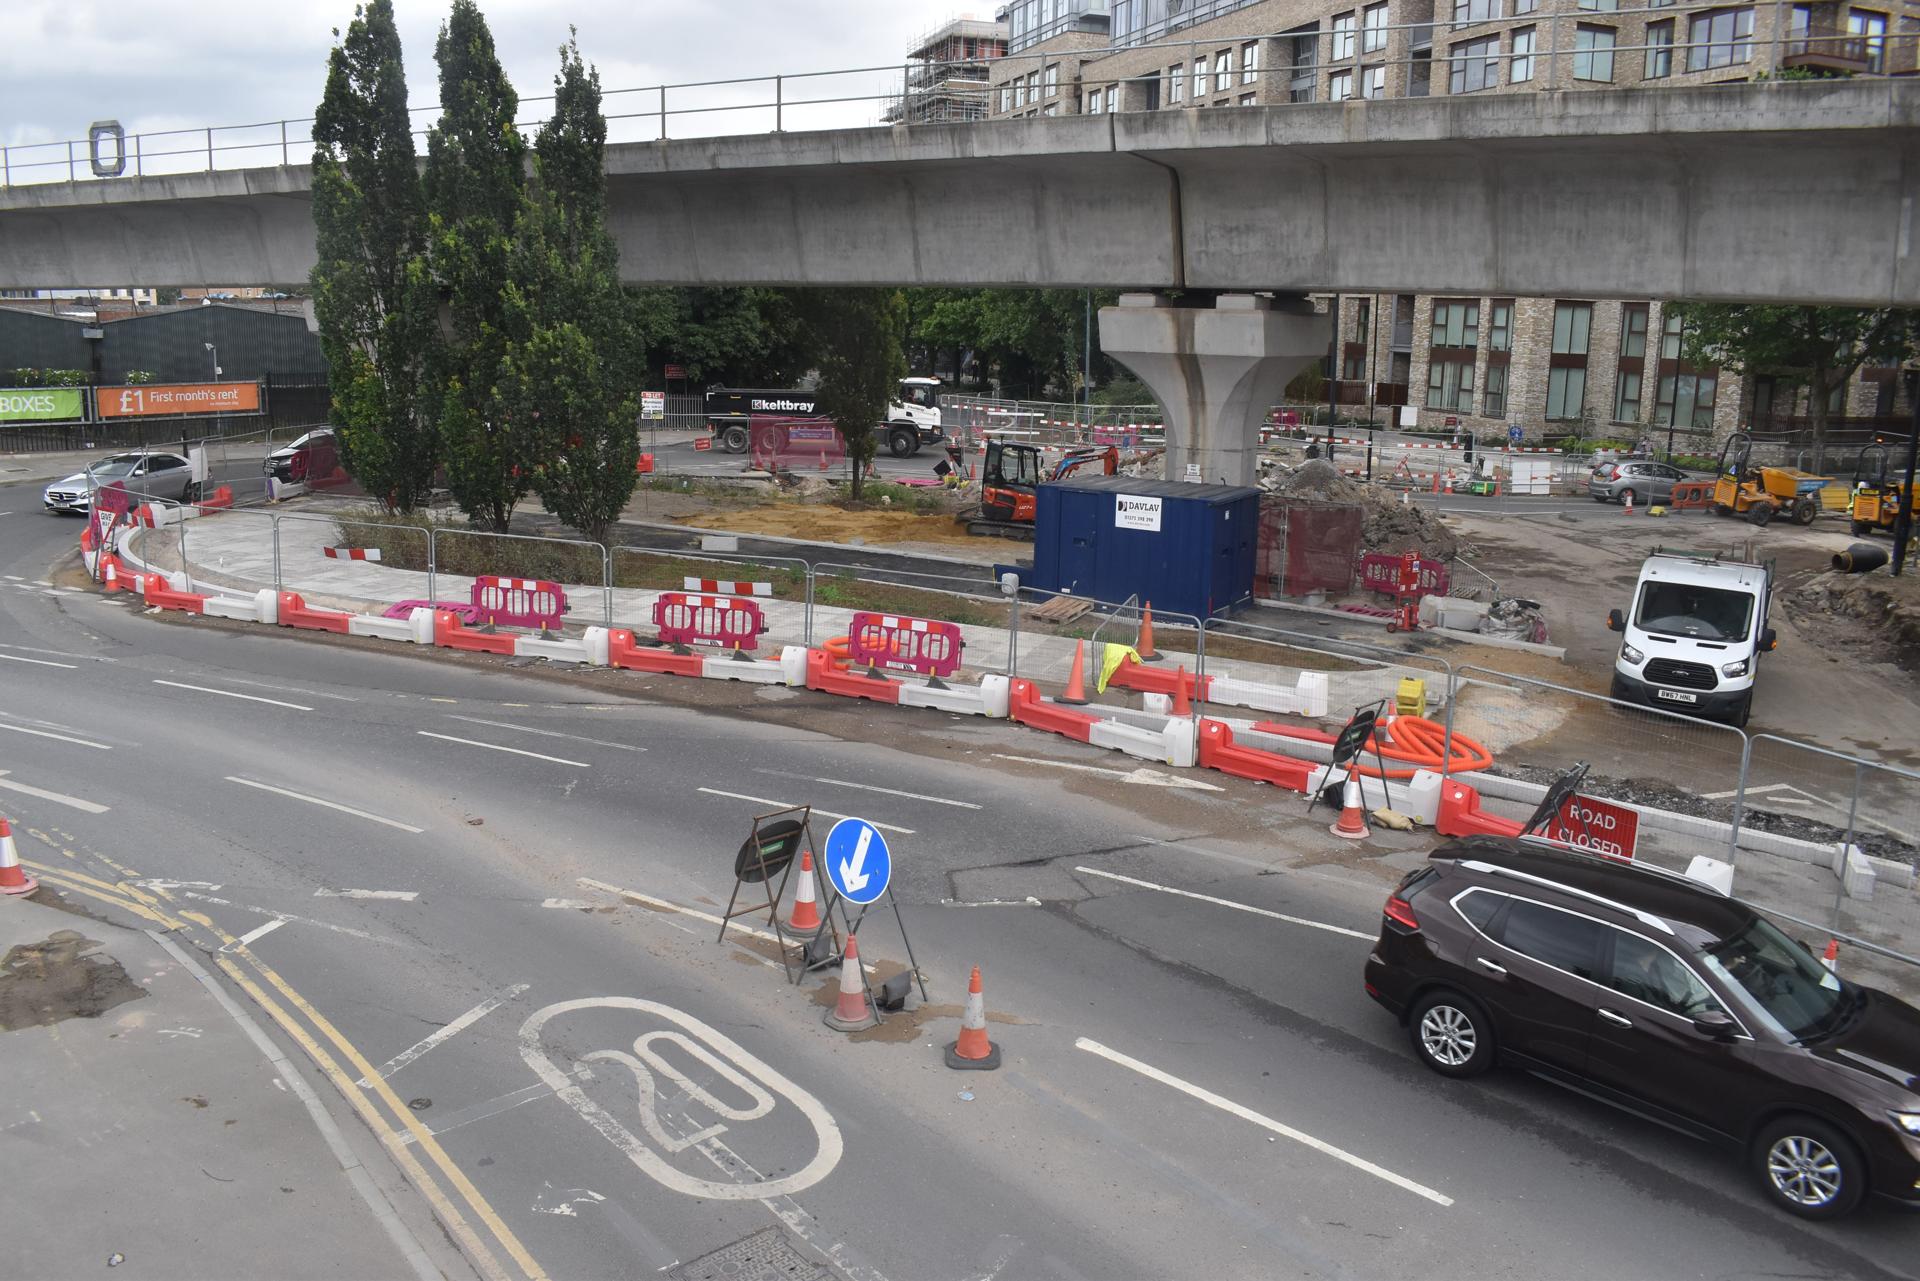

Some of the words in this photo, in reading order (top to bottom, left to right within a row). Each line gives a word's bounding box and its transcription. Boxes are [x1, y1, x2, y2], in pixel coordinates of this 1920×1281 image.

[0, 395, 55, 412] BOXES
[120, 389, 144, 413] £1
[150, 391, 173, 403] First
[175, 389, 216, 403] month's
[762, 400, 815, 413] keltbray
[1129, 501, 1160, 512] DAVLAV
[101, 512, 112, 521] GIVE
[1661, 690, 1679, 700] BW67
[1570, 804, 1616, 830] ROAD
[1558, 827, 1622, 856] CLOSED
[572, 1030, 776, 1153] 20
